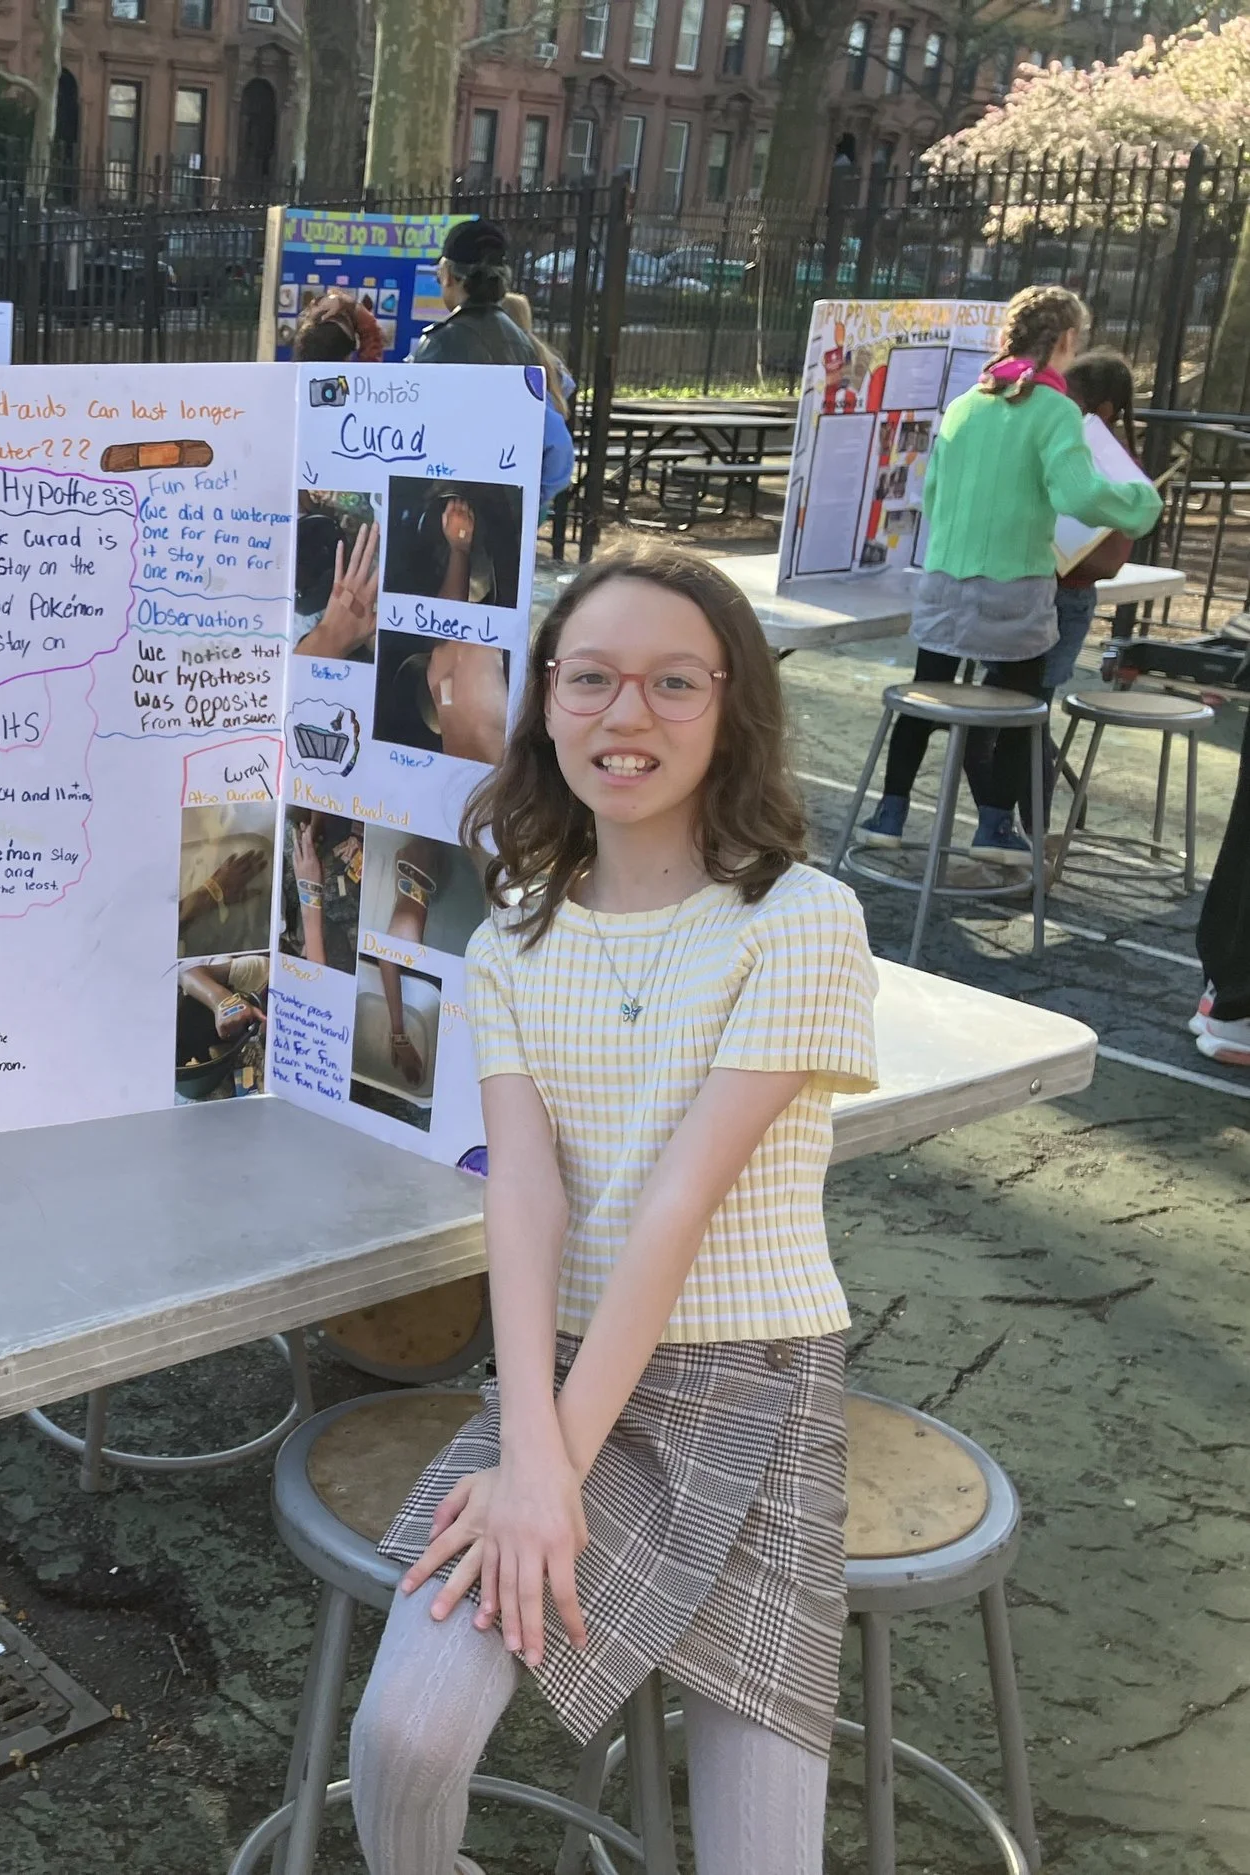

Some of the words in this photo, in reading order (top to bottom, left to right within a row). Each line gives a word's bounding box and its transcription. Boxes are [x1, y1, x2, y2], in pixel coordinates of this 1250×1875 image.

[353, 375, 421, 404] Photo's
[132, 400, 168, 420] last
[180, 400, 246, 425] longer
[339, 412, 426, 453] Curad
[147, 471, 186, 497] Fun
[178, 503, 204, 521] did
[213, 507, 224, 520] a
[98, 528, 118, 551] is
[247, 536, 272, 551] and
[39, 561, 57, 575] on
[70, 555, 96, 576] the
[143, 541, 157, 557] it
[216, 553, 237, 567] on
[137, 598, 264, 631] Observations
[414, 603, 473, 638] Sheer
[42, 637, 66, 651] on
[181, 646, 243, 666] notice
[250, 643, 281, 659] that
[176, 665, 272, 692] hypothesis
[21, 786, 50, 802] and
[4, 866, 35, 880] and
[363, 932, 416, 967] During
